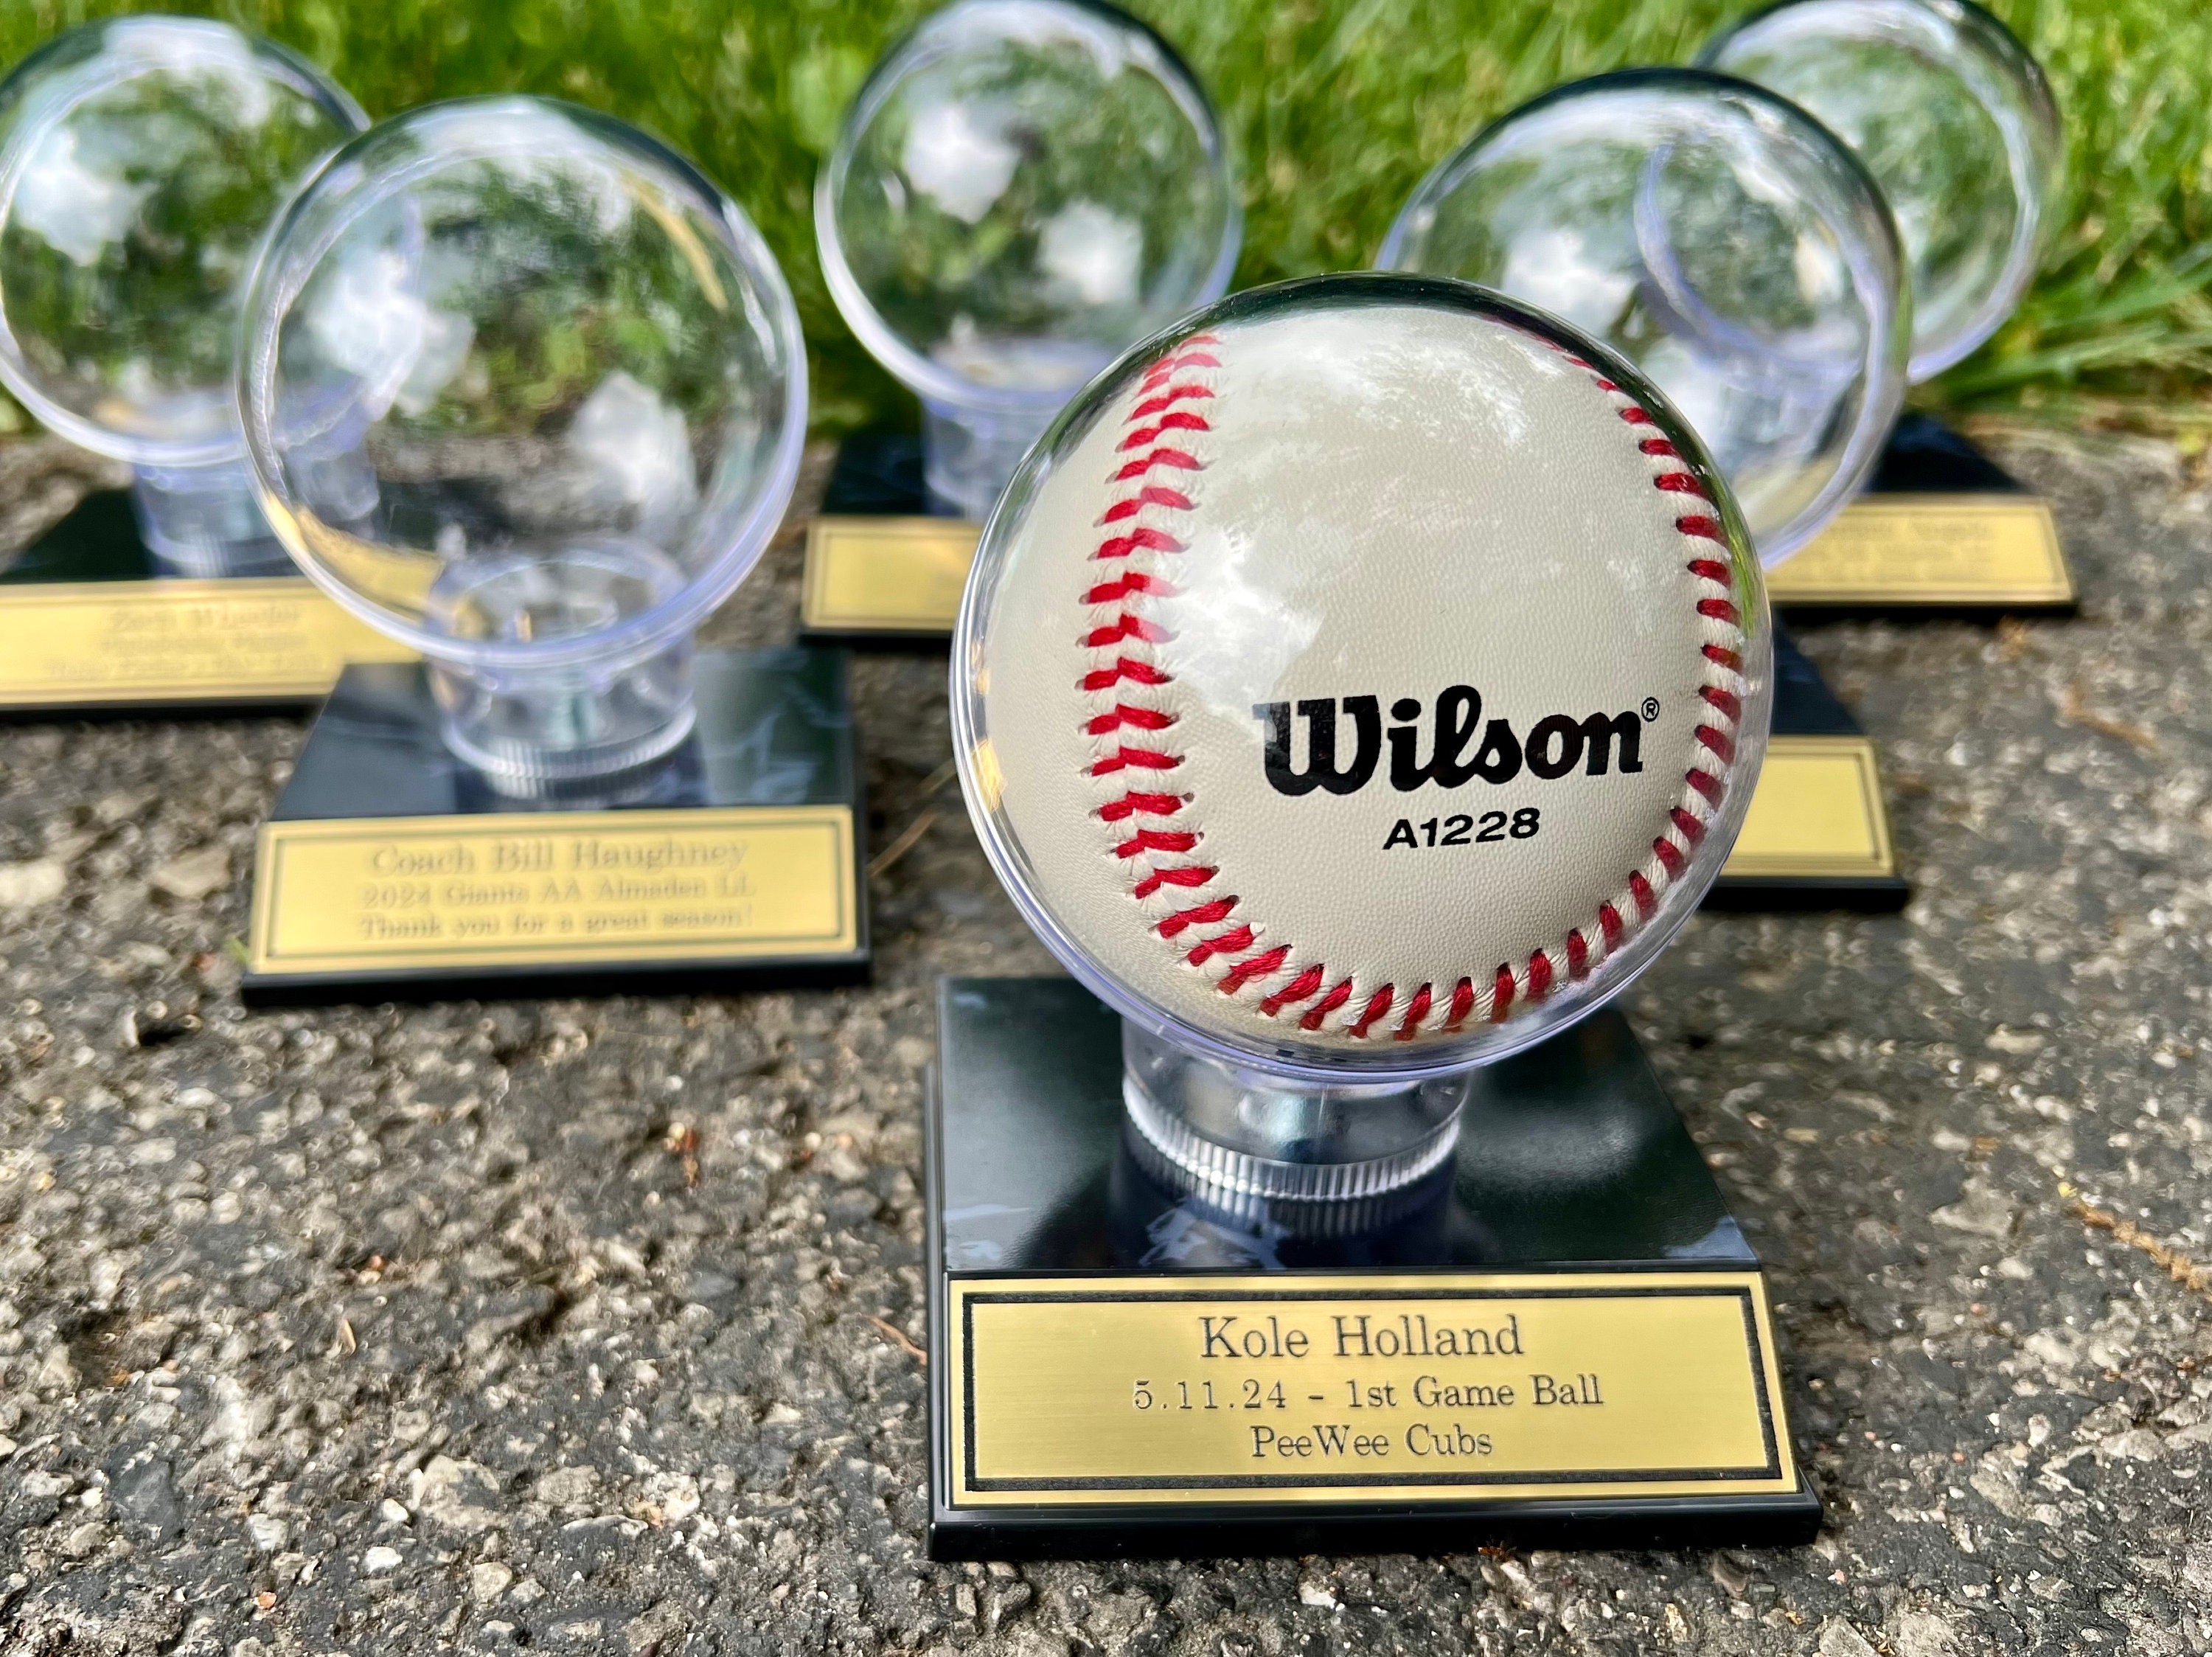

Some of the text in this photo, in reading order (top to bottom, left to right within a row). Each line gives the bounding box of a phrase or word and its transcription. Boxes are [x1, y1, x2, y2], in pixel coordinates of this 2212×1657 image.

[1382, 807, 1540, 850] A1228
[371, 836, 748, 877] Coach Bill Haughney
[362, 883, 431, 909] 2024
[444, 880, 529, 906] Giants
[540, 877, 581, 903] AA
[360, 910, 441, 939] Thank
[458, 915, 501, 939] you
[512, 909, 548, 935] for
[559, 912, 574, 932] a
[587, 908, 648, 934] great
[1198, 1313, 1525, 1358] Kole Holland
[1133, 1378, 1287, 1409] 5.11.24
[1346, 1378, 1397, 1408] 1st
[1413, 1375, 1514, 1408] Game
[1528, 1372, 1604, 1406] Ball
[1250, 1422, 1493, 1458] PeeWee Cubs
